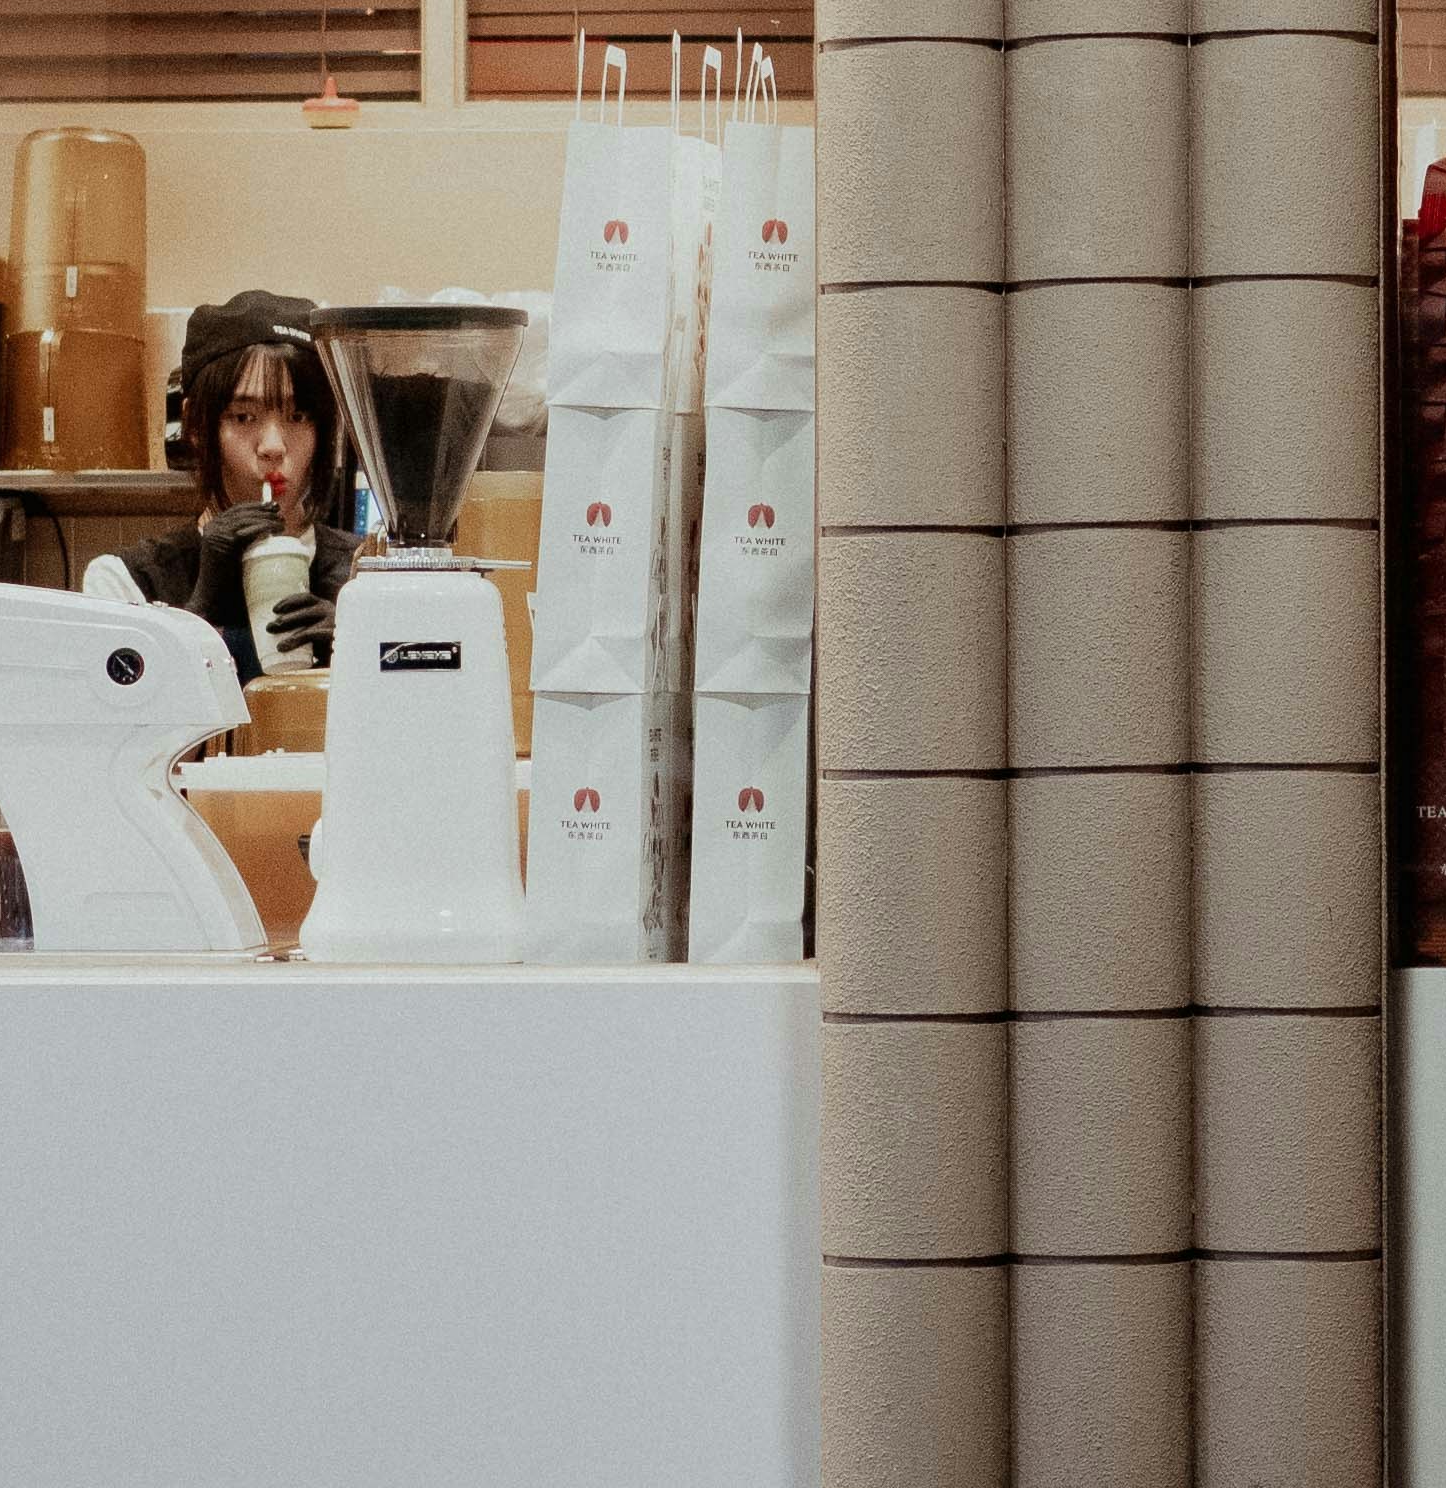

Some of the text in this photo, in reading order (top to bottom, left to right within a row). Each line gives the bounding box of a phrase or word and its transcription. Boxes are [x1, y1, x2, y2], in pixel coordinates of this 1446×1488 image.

[590, 251, 638, 262] TEA WHITE
[748, 251, 800, 262] TEA WHITE
[573, 535, 622, 545] TEA WHITE
[735, 536, 787, 547] TEA WHITE
[561, 821, 611, 831] TEA WHITE
[725, 820, 777, 830] TEA WHITE
